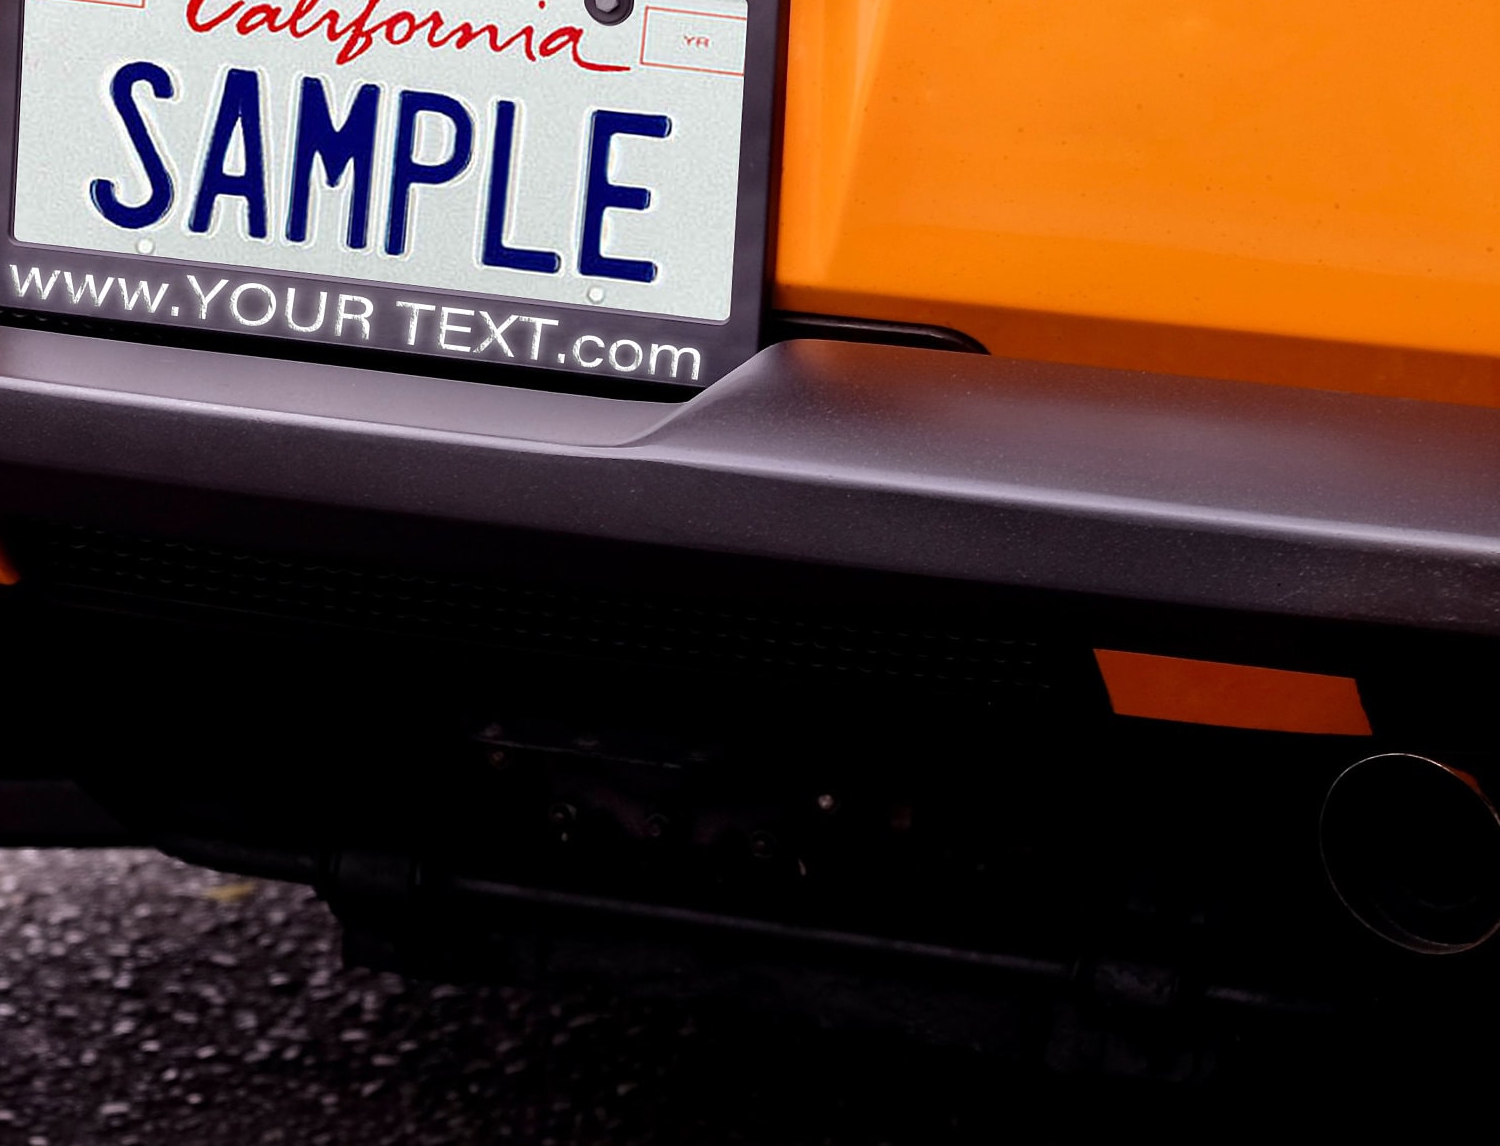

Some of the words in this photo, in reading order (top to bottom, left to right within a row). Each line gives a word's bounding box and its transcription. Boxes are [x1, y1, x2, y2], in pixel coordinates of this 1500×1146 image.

[90, 61, 672, 284] SAMPLE
[9, 264, 374, 340] www.YOUR
[396, 301, 701, 381] TEXT.com
